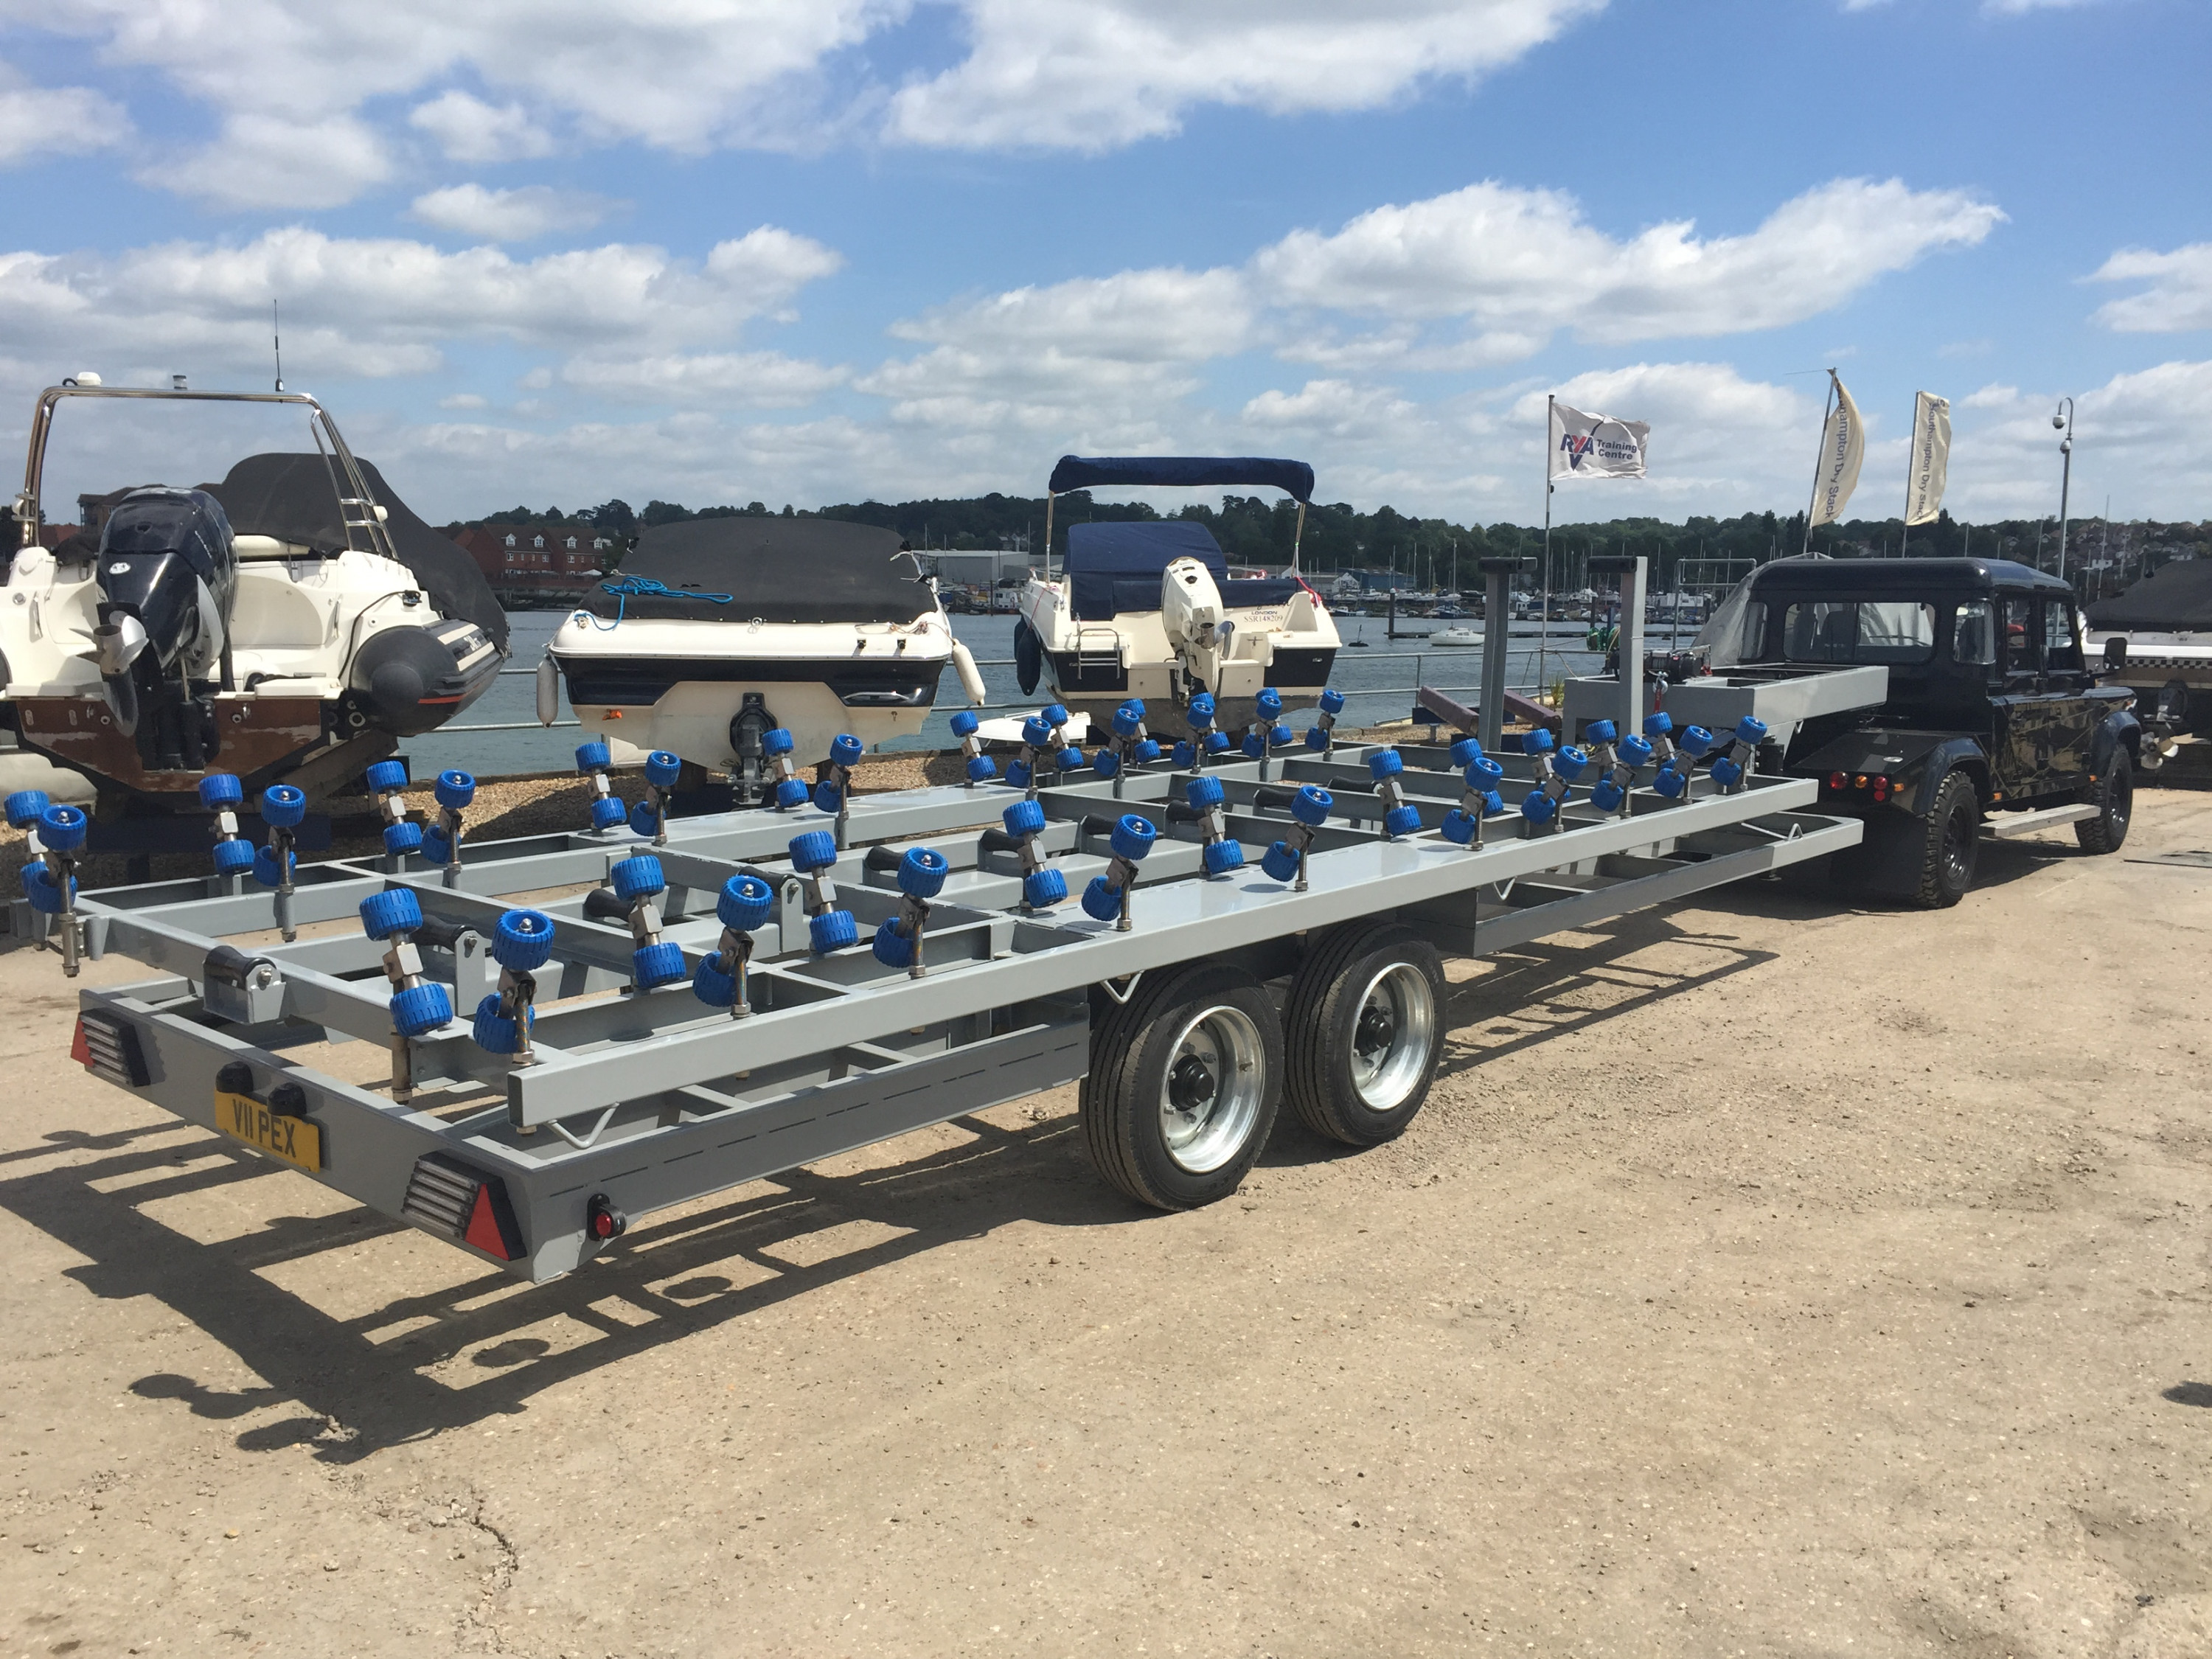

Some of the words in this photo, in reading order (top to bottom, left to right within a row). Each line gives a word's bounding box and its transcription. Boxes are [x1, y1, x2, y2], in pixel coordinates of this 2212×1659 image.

[1560, 434, 1594, 455] RYA
[1597, 439, 1638, 453] Training
[1598, 448, 1633, 460] Centre
[1831, 463, 1845, 483] Dry
[1919, 474, 1930, 492] Dry
[1825, 486, 1839, 518] Stack
[258, 1109, 296, 1158] PEX
